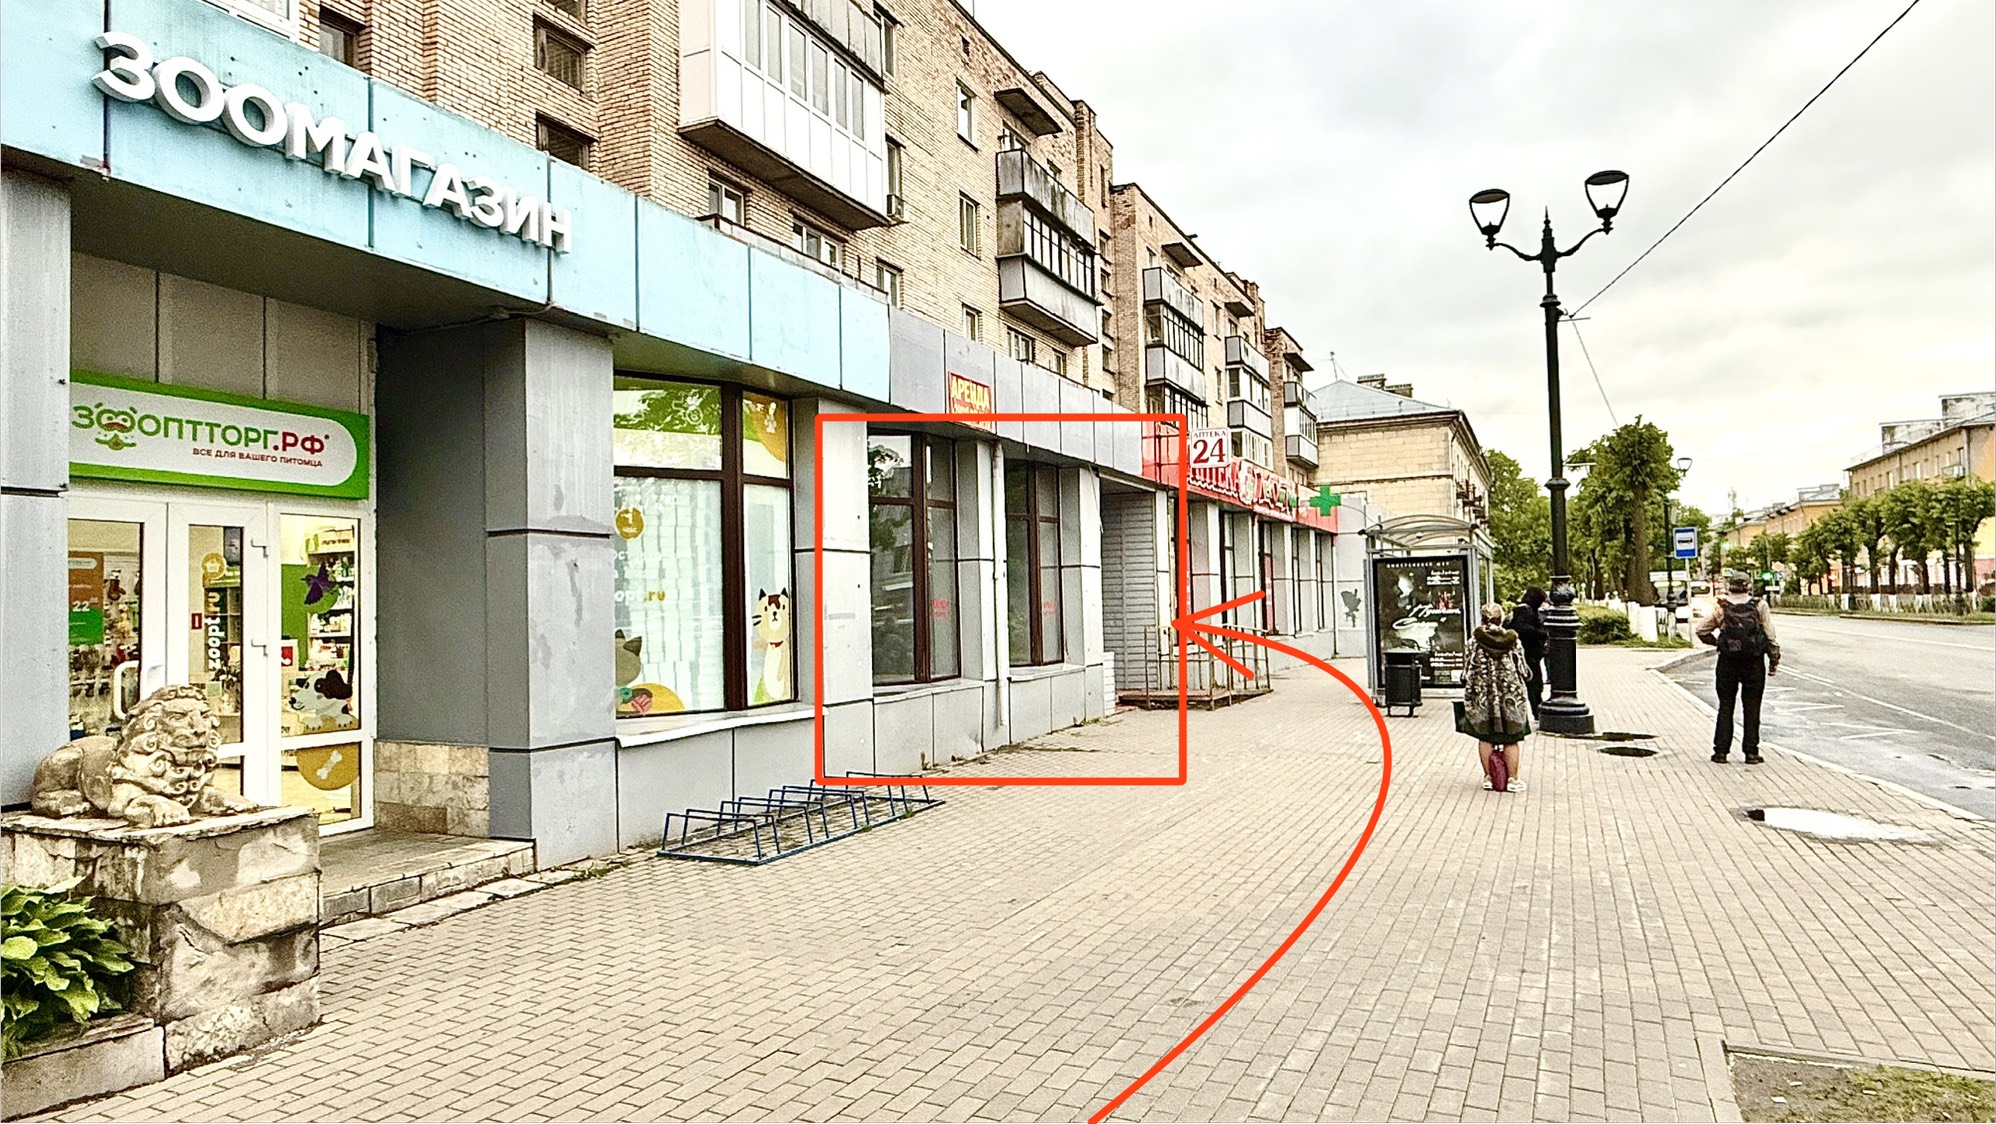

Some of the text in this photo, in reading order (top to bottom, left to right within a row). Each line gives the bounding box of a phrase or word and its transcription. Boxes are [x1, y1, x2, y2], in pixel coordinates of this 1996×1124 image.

[91, 31, 572, 254] ЗООМАГАЗИН
[950, 376, 991, 411] АРЕНДА
[1193, 430, 1227, 438] АПТЕКА
[192, 447, 323, 468] ВСЕ ДЛЯ ВАШЕГО ПИТОМЦА
[1192, 438, 1226, 464] 24
